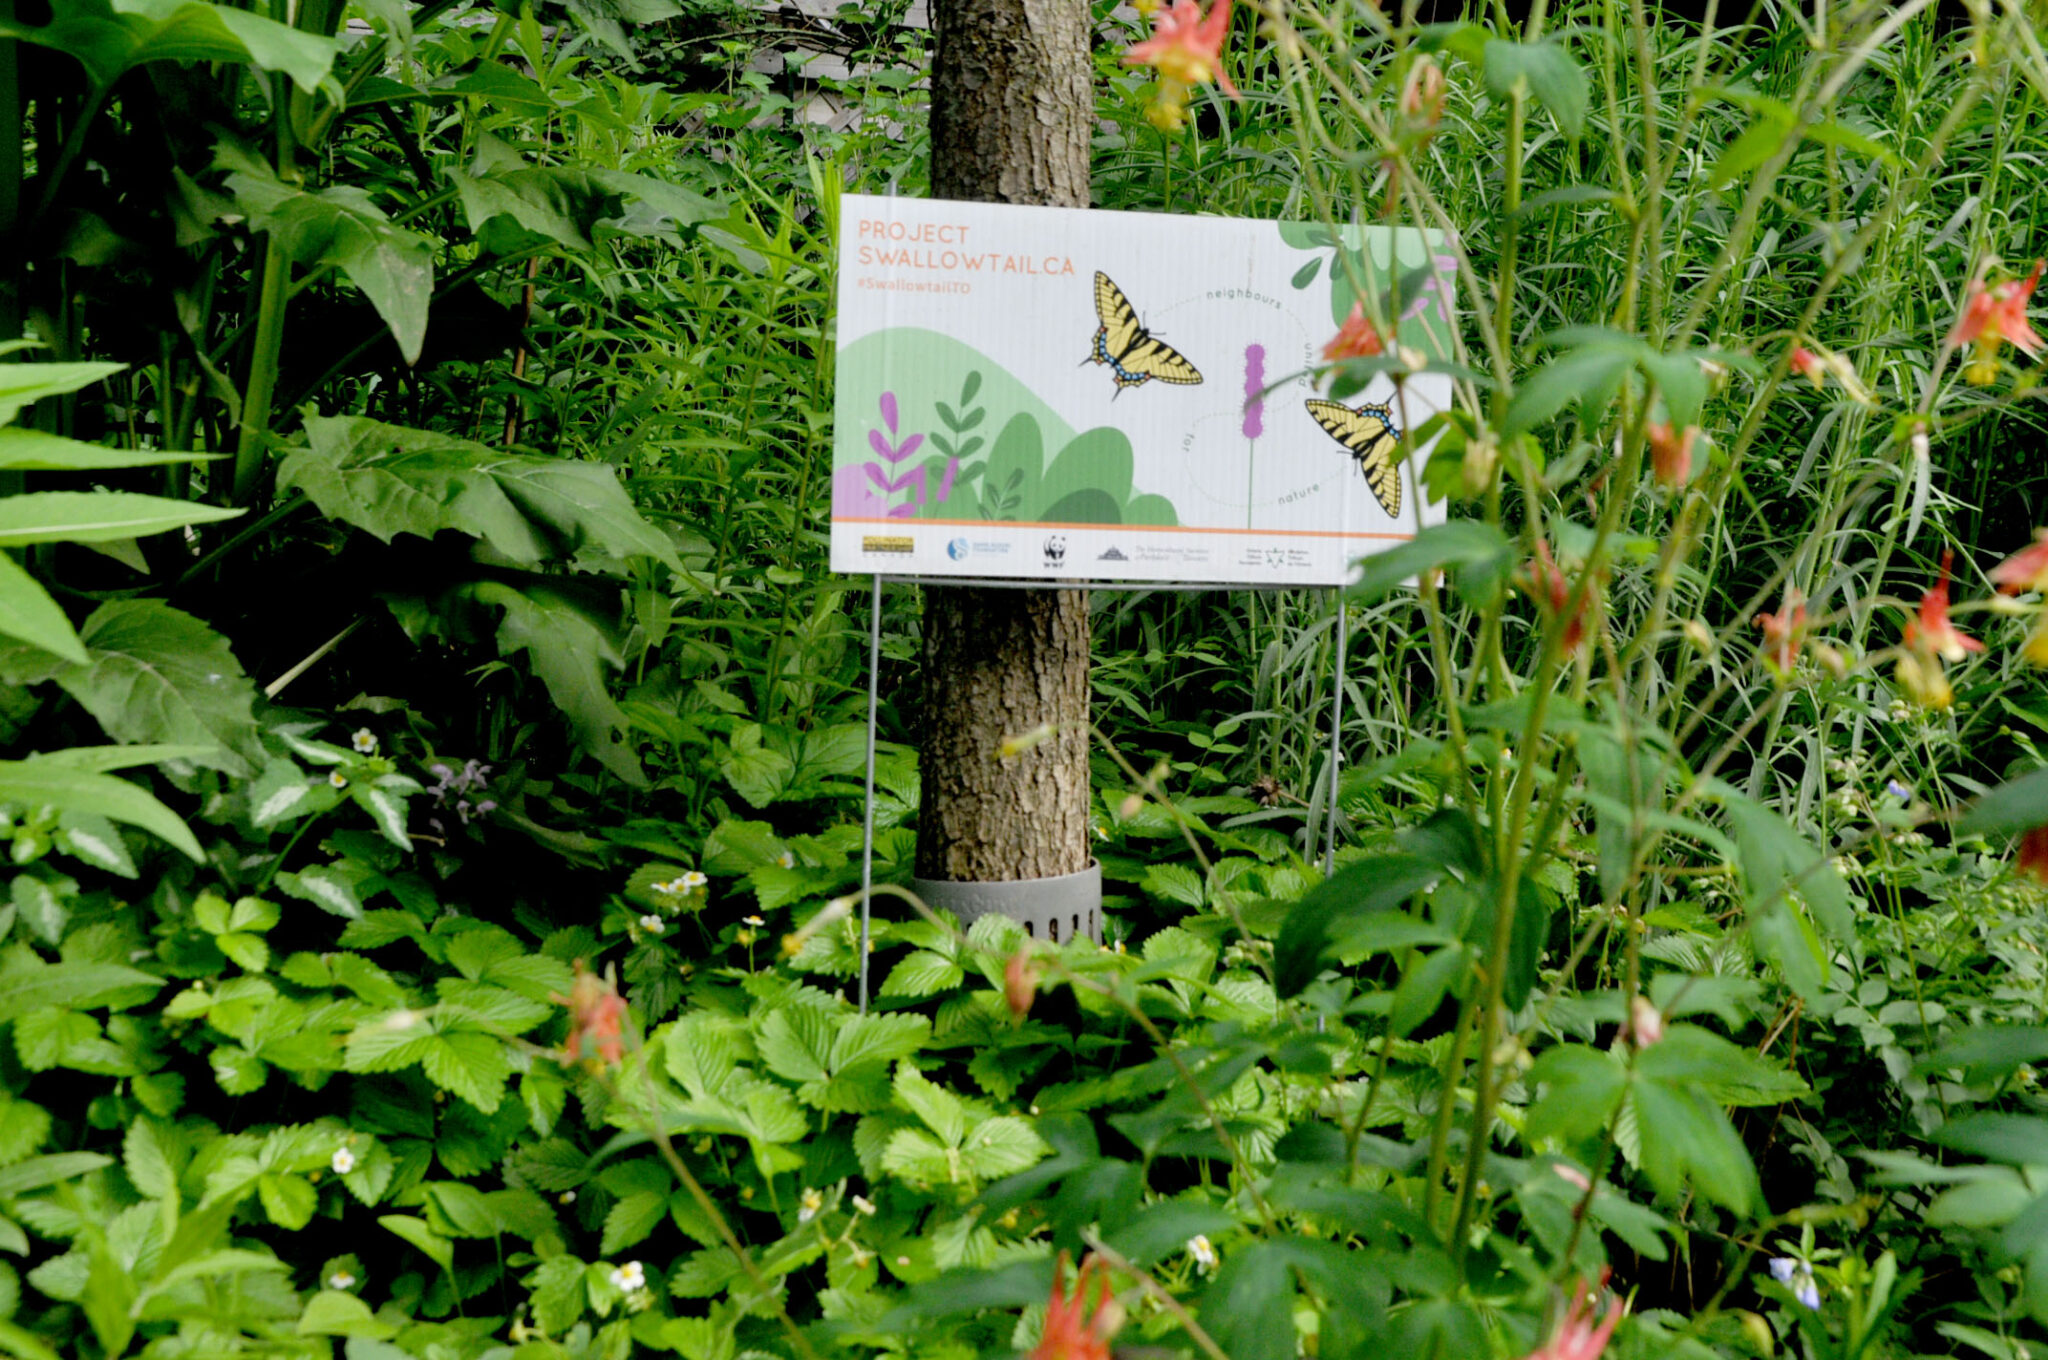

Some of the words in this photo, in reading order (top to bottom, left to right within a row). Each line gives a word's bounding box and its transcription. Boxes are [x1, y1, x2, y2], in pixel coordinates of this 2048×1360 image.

[858, 219, 970, 244] PROJECT
[858, 245, 1075, 275] SWALLOWTAIL.CA
[1206, 287, 1282, 310] neighbours
[1298, 342, 1313, 388] unitd
[1182, 432, 1195, 452] for
[1278, 483, 1320, 506] nature
